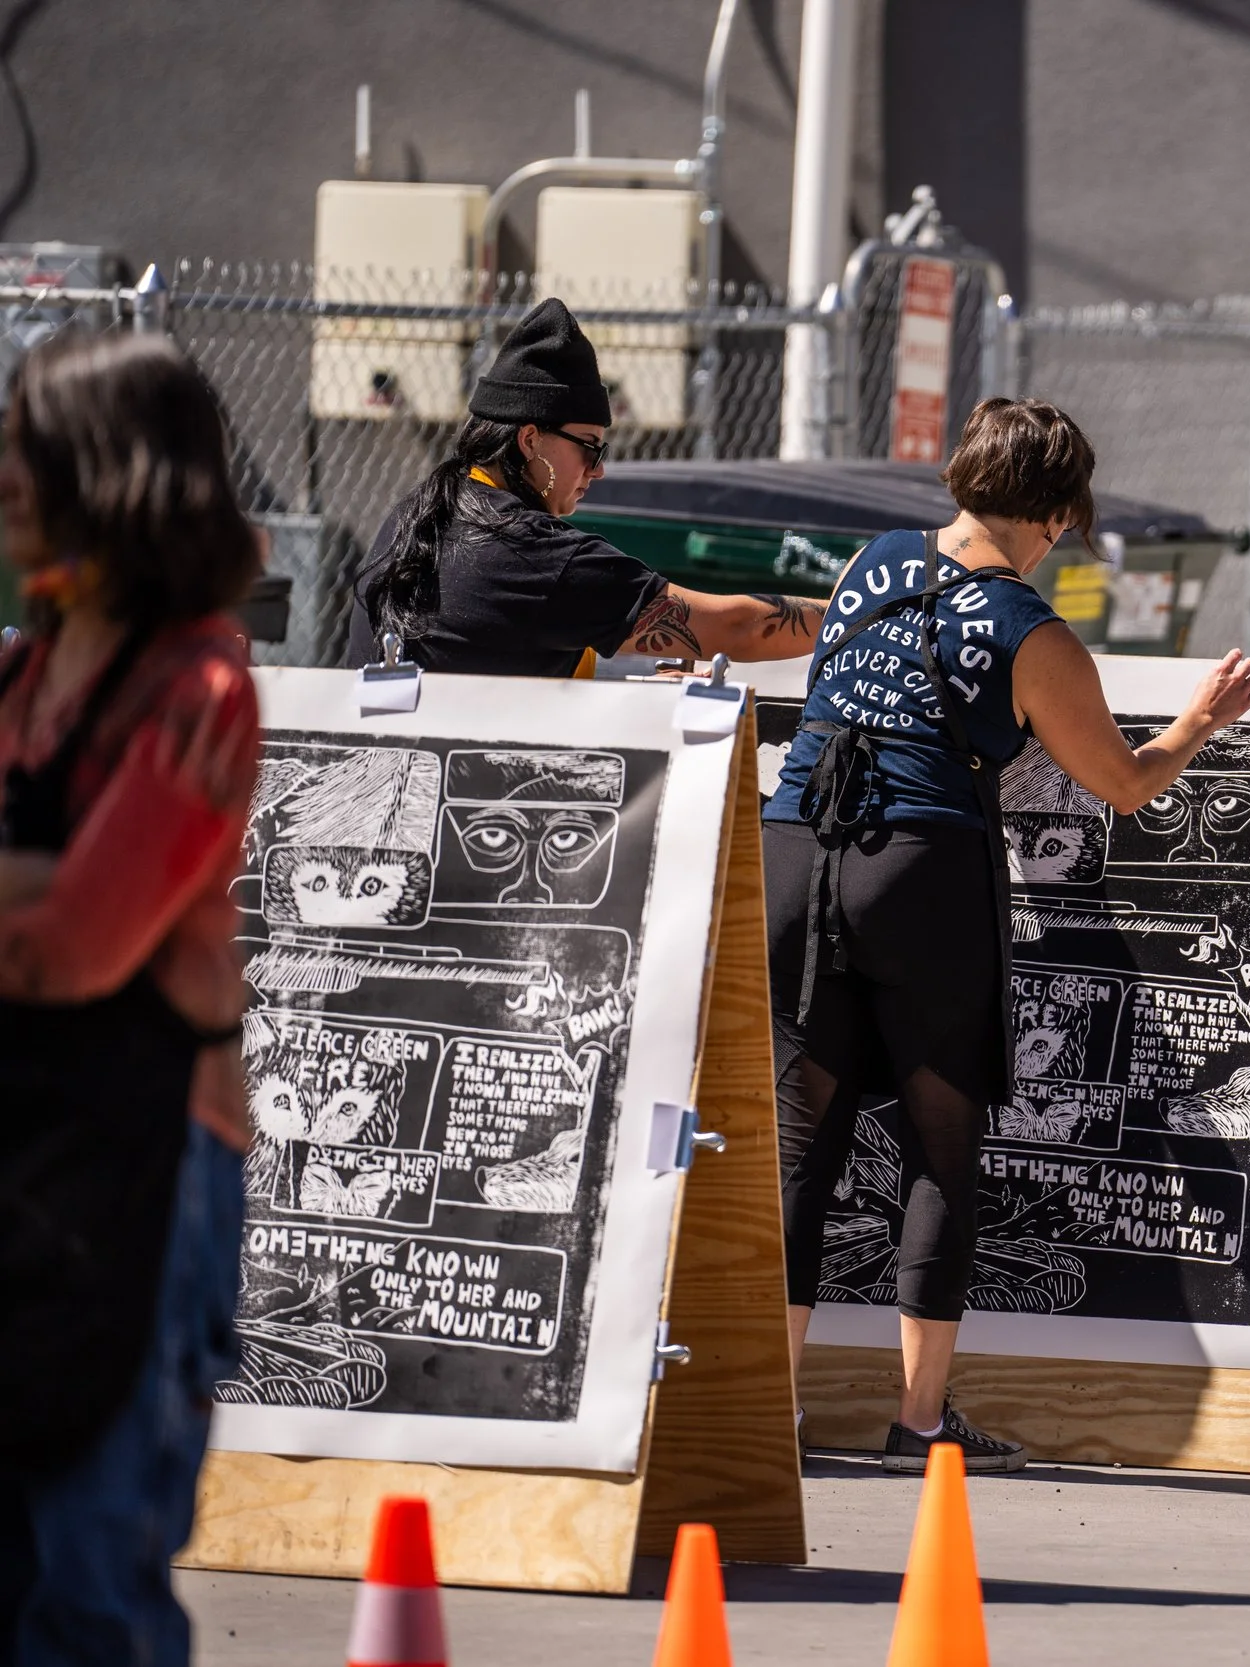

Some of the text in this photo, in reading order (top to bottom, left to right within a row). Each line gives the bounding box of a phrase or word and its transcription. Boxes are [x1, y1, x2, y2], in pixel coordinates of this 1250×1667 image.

[897, 606, 947, 634] RINT
[823, 649, 900, 681] SILVER
[854, 680, 902, 708] NEW
[829, 692, 913, 728] MEXICO
[1050, 980, 1110, 1002] GREEN
[1135, 987, 1237, 1014] I REALIZED
[568, 993, 624, 1043] BANG!
[1018, 1000, 1057, 1028] RE
[1180, 1011, 1204, 1026] AND
[1208, 1015, 1237, 1029] HAVE
[1131, 1035, 1164, 1048] THAT
[1134, 1021, 1182, 1037] KNOWN
[1189, 1025, 1219, 1040] EVER
[361, 1033, 429, 1061] GREEN
[454, 1042, 562, 1071] I REALIZED
[1130, 1048, 1206, 1066] SOMETHING
[300, 1057, 368, 1089] FIRE
[501, 1069, 528, 1085] AND
[530, 1071, 561, 1089] HAVE
[1130, 1061, 1195, 1077] NEW TO ME
[452, 1080, 505, 1100] KNOWN
[511, 1085, 542, 1102] EVER
[1014, 1081, 1121, 1106] YING IN HER
[1127, 1075, 1194, 1090] IN THOSE
[1127, 1087, 1155, 1100] EYES
[448, 1097, 484, 1112] THAT
[1082, 1104, 1115, 1121] EYES
[446, 1111, 528, 1132] SOMETHING
[446, 1126, 516, 1144] NEW TO ME
[307, 1146, 436, 1176] DYING IN HER
[443, 1140, 514, 1159] IN THOSE
[442, 1155, 472, 1171] EYES
[980, 1153, 1184, 1197] METHING KNOWN
[392, 1173, 428, 1194] EYES
[1068, 1188, 1225, 1225] ONLY TO HER AND
[1073, 1208, 1238, 1257] THE MOUNTAIN
[250, 1228, 500, 1280] OMETHING KNOWN
[370, 1269, 541, 1311] ONLY TO HER AND
[377, 1290, 555, 1346] THE MOUNTAIN
